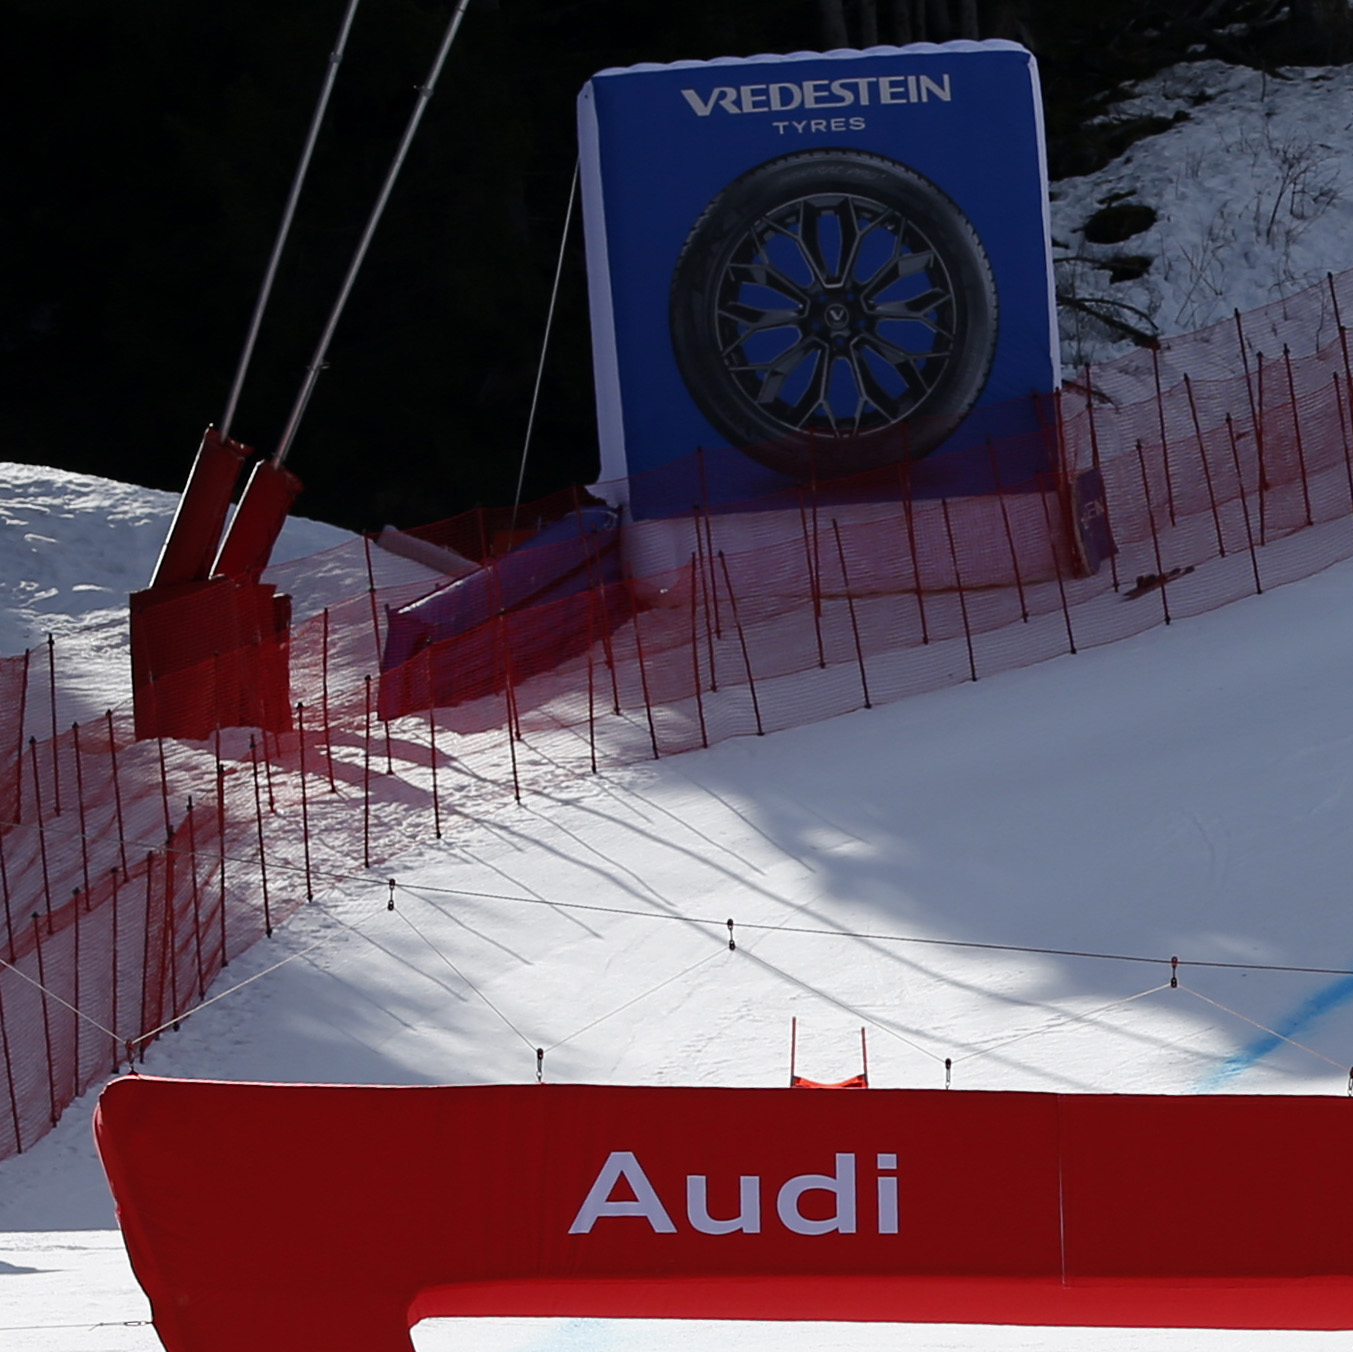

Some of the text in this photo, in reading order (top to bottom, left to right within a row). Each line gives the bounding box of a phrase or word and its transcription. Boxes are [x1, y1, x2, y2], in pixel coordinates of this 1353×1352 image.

[682, 74, 951, 117] VREDESTEIN
[773, 117, 866, 135] TYRES
[568, 1152, 898, 1235] Audi
